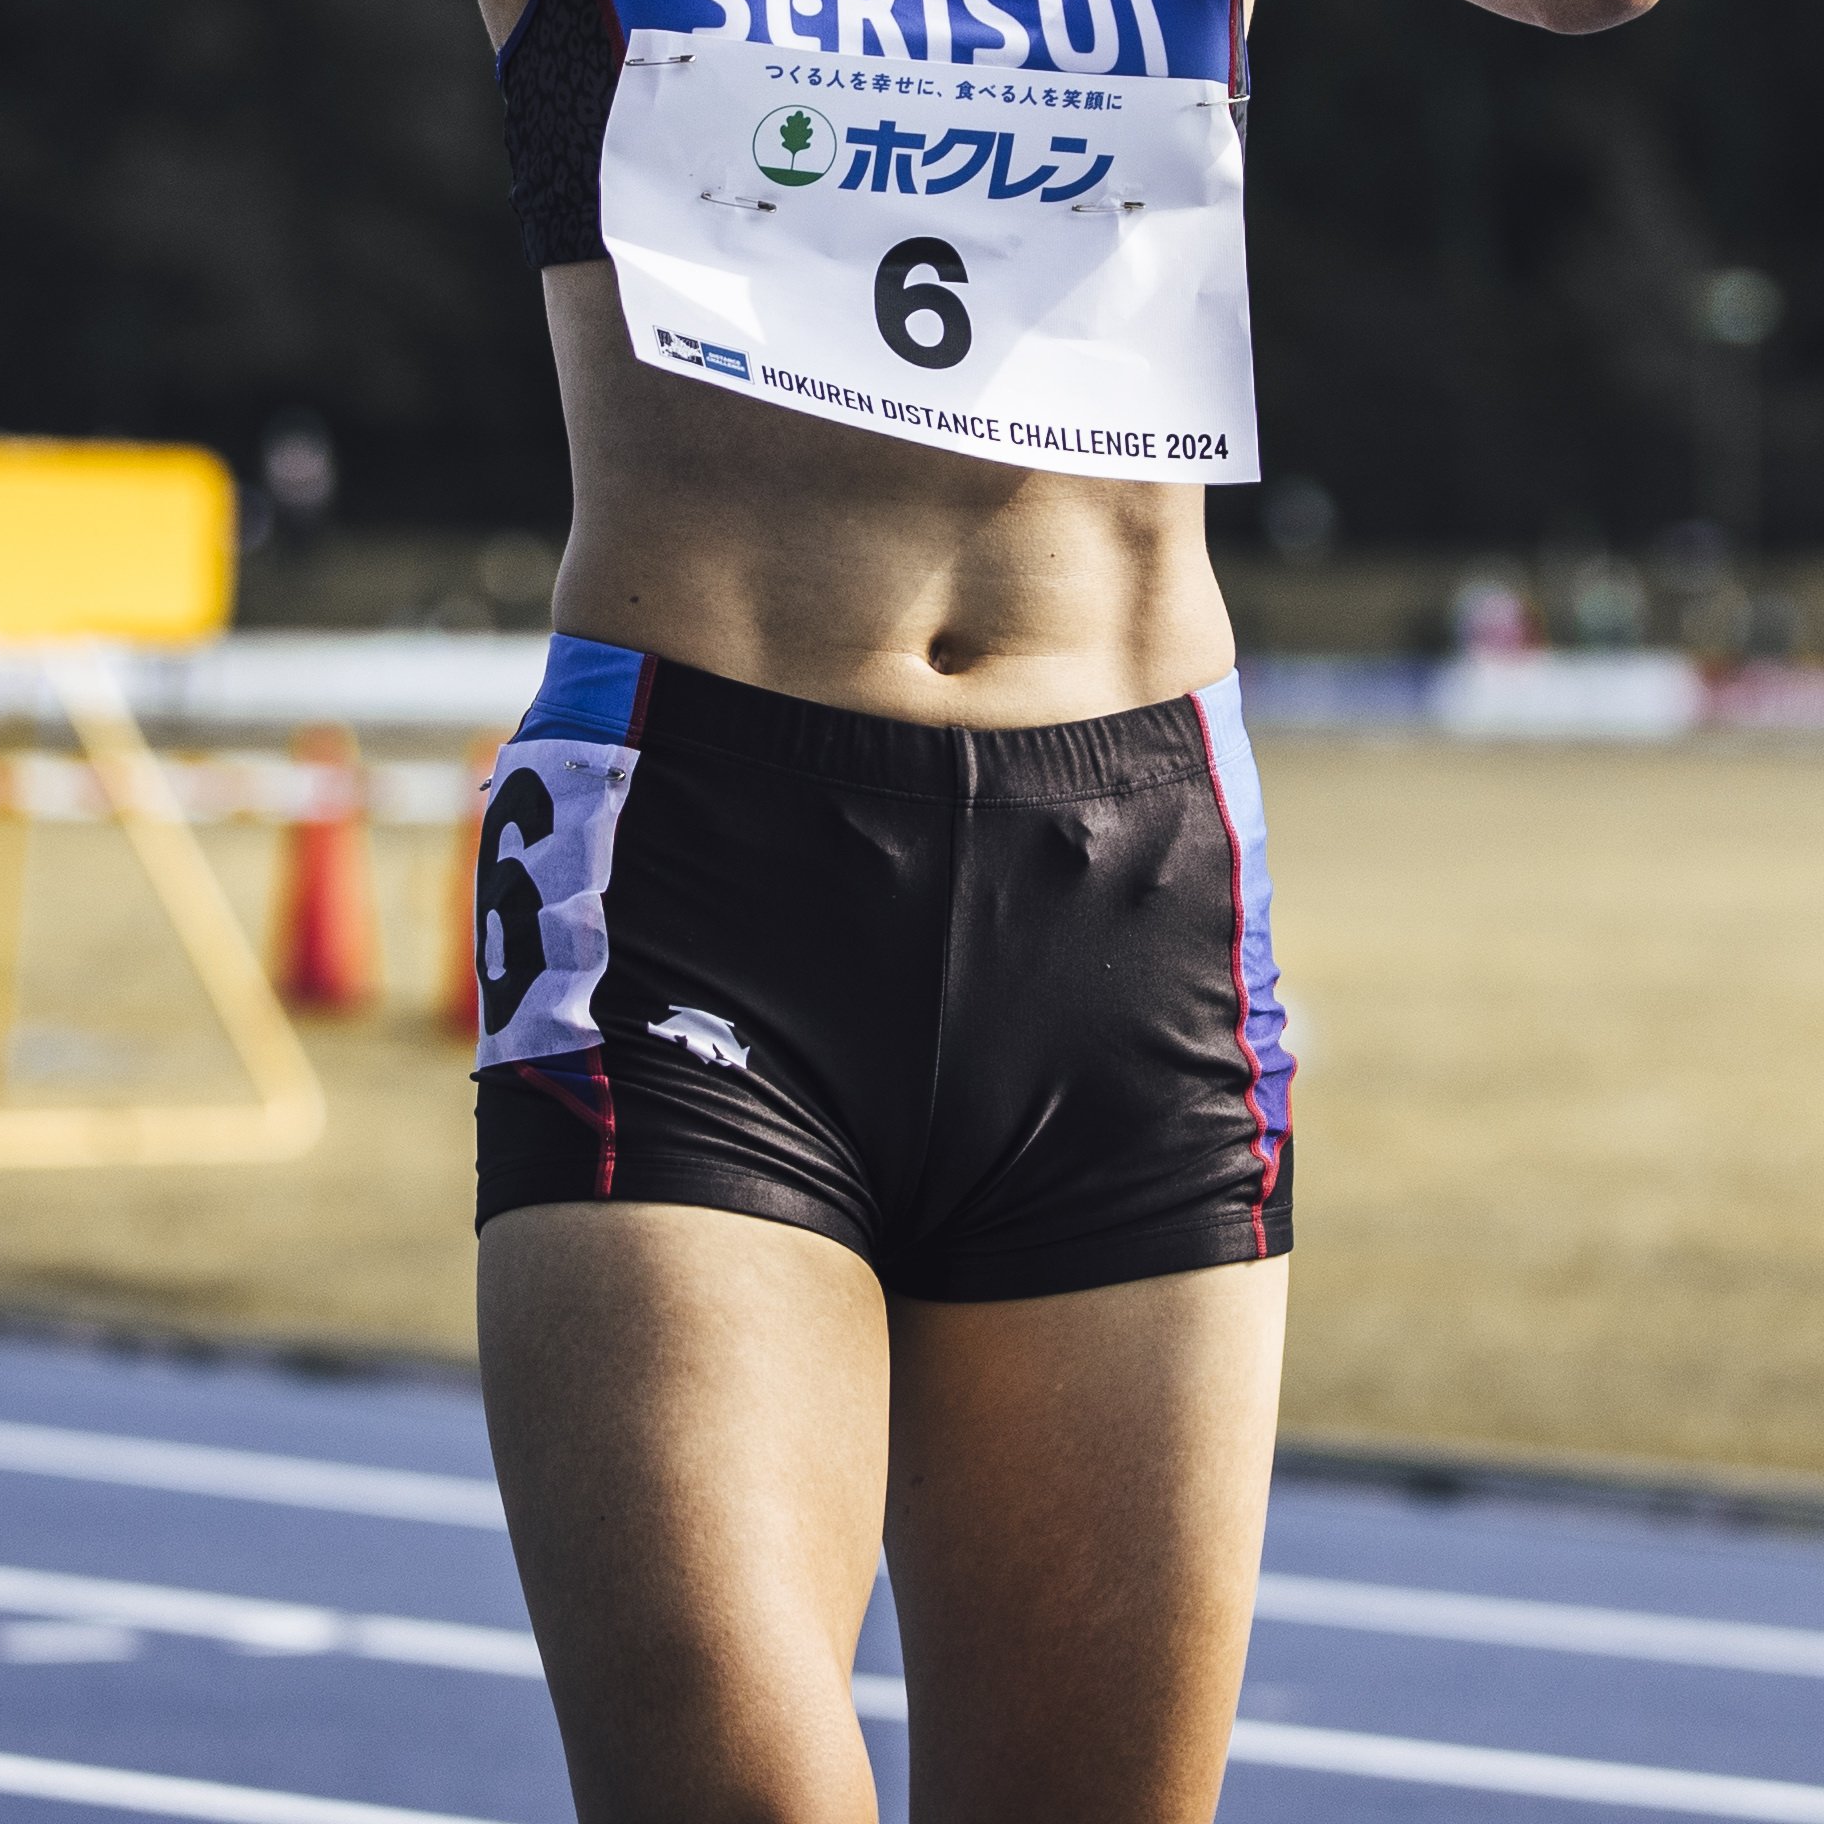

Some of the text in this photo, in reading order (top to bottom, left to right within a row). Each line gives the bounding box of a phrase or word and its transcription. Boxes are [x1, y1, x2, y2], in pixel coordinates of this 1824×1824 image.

[764, 64, 1123, 111] つくる人を幸せに、食べる人を笑顔に
[837, 120, 1116, 203] ホクレン
[874, 236, 973, 369] 6
[762, 366, 1229, 460] HOKUREN DISTANCE CHALLENGE 2024
[477, 767, 554, 1036] 6
